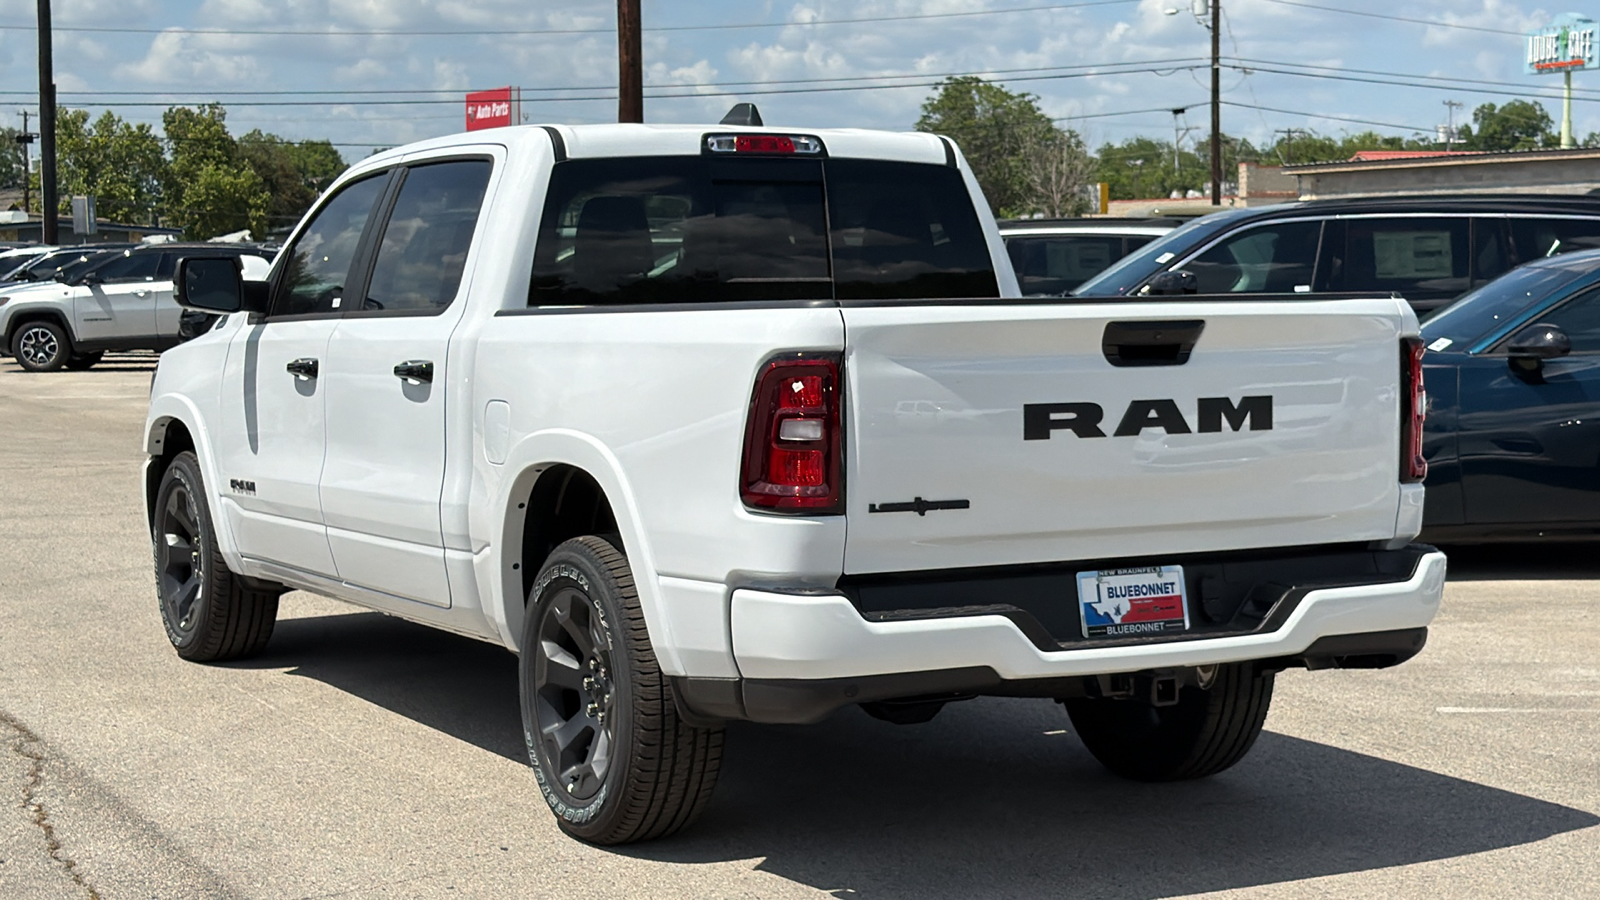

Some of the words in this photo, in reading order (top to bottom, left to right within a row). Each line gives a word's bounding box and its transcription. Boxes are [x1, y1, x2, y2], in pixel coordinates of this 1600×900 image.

[1528, 34, 1559, 63] ADOBE
[1568, 30, 1592, 58] CAFE
[476, 104, 491, 119] Auto
[492, 102, 509, 117] Parts
[1023, 395, 1273, 441] RAM
[1107, 582, 1175, 598] BLUEBONNET
[1106, 622, 1164, 634] BLUEBONNET
